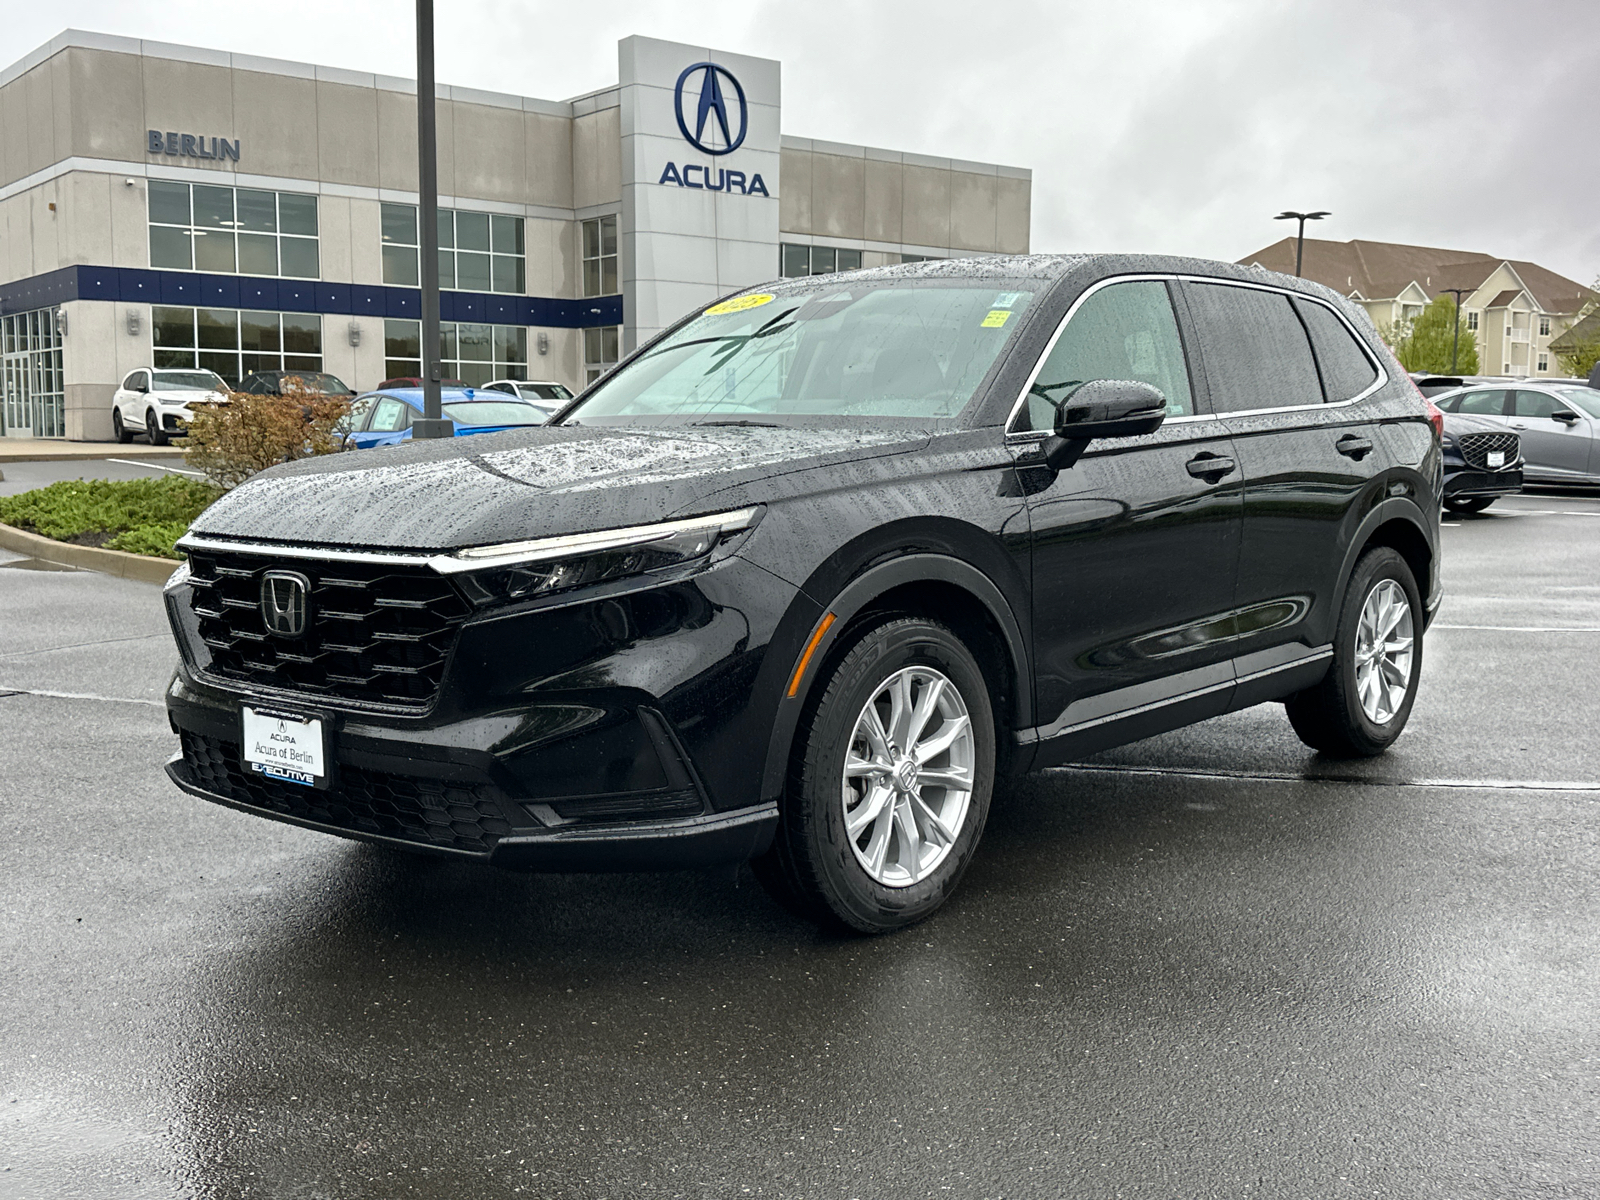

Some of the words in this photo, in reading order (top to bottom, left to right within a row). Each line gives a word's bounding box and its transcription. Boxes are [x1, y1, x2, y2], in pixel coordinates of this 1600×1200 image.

[147, 129, 240, 162] BERLIN
[659, 161, 769, 197] ACURA
[270, 732, 296, 745] ACURA
[255, 741, 277, 757] Acura
[279, 747, 287, 759] of
[290, 749, 314, 764] Berlin
[252, 762, 314, 784] EXECUTIVE
